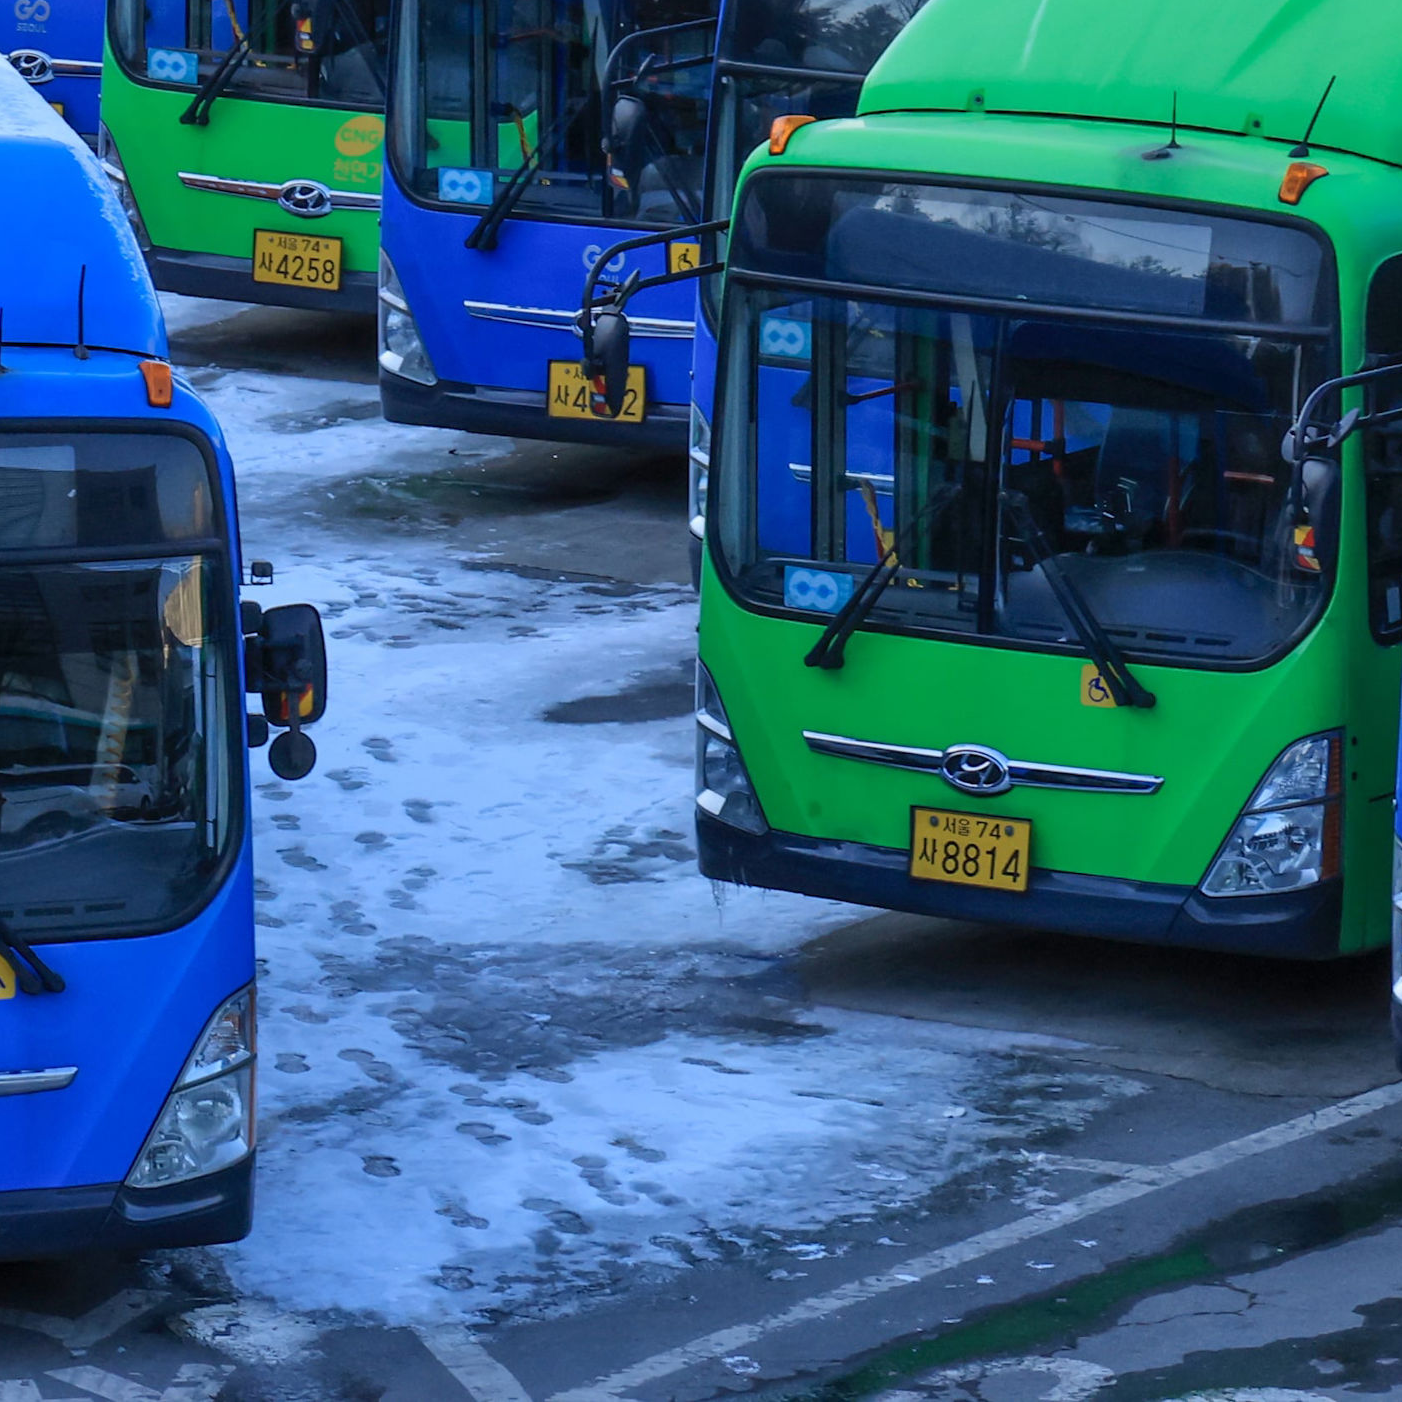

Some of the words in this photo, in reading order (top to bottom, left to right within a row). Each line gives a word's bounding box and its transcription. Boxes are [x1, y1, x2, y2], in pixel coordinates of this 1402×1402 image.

[277, 236, 298, 251] 서울
[301, 238, 320, 252] 74
[554, 385, 637, 416] 사42
[943, 817, 971, 837] 서울
[976, 821, 1001, 840] 74
